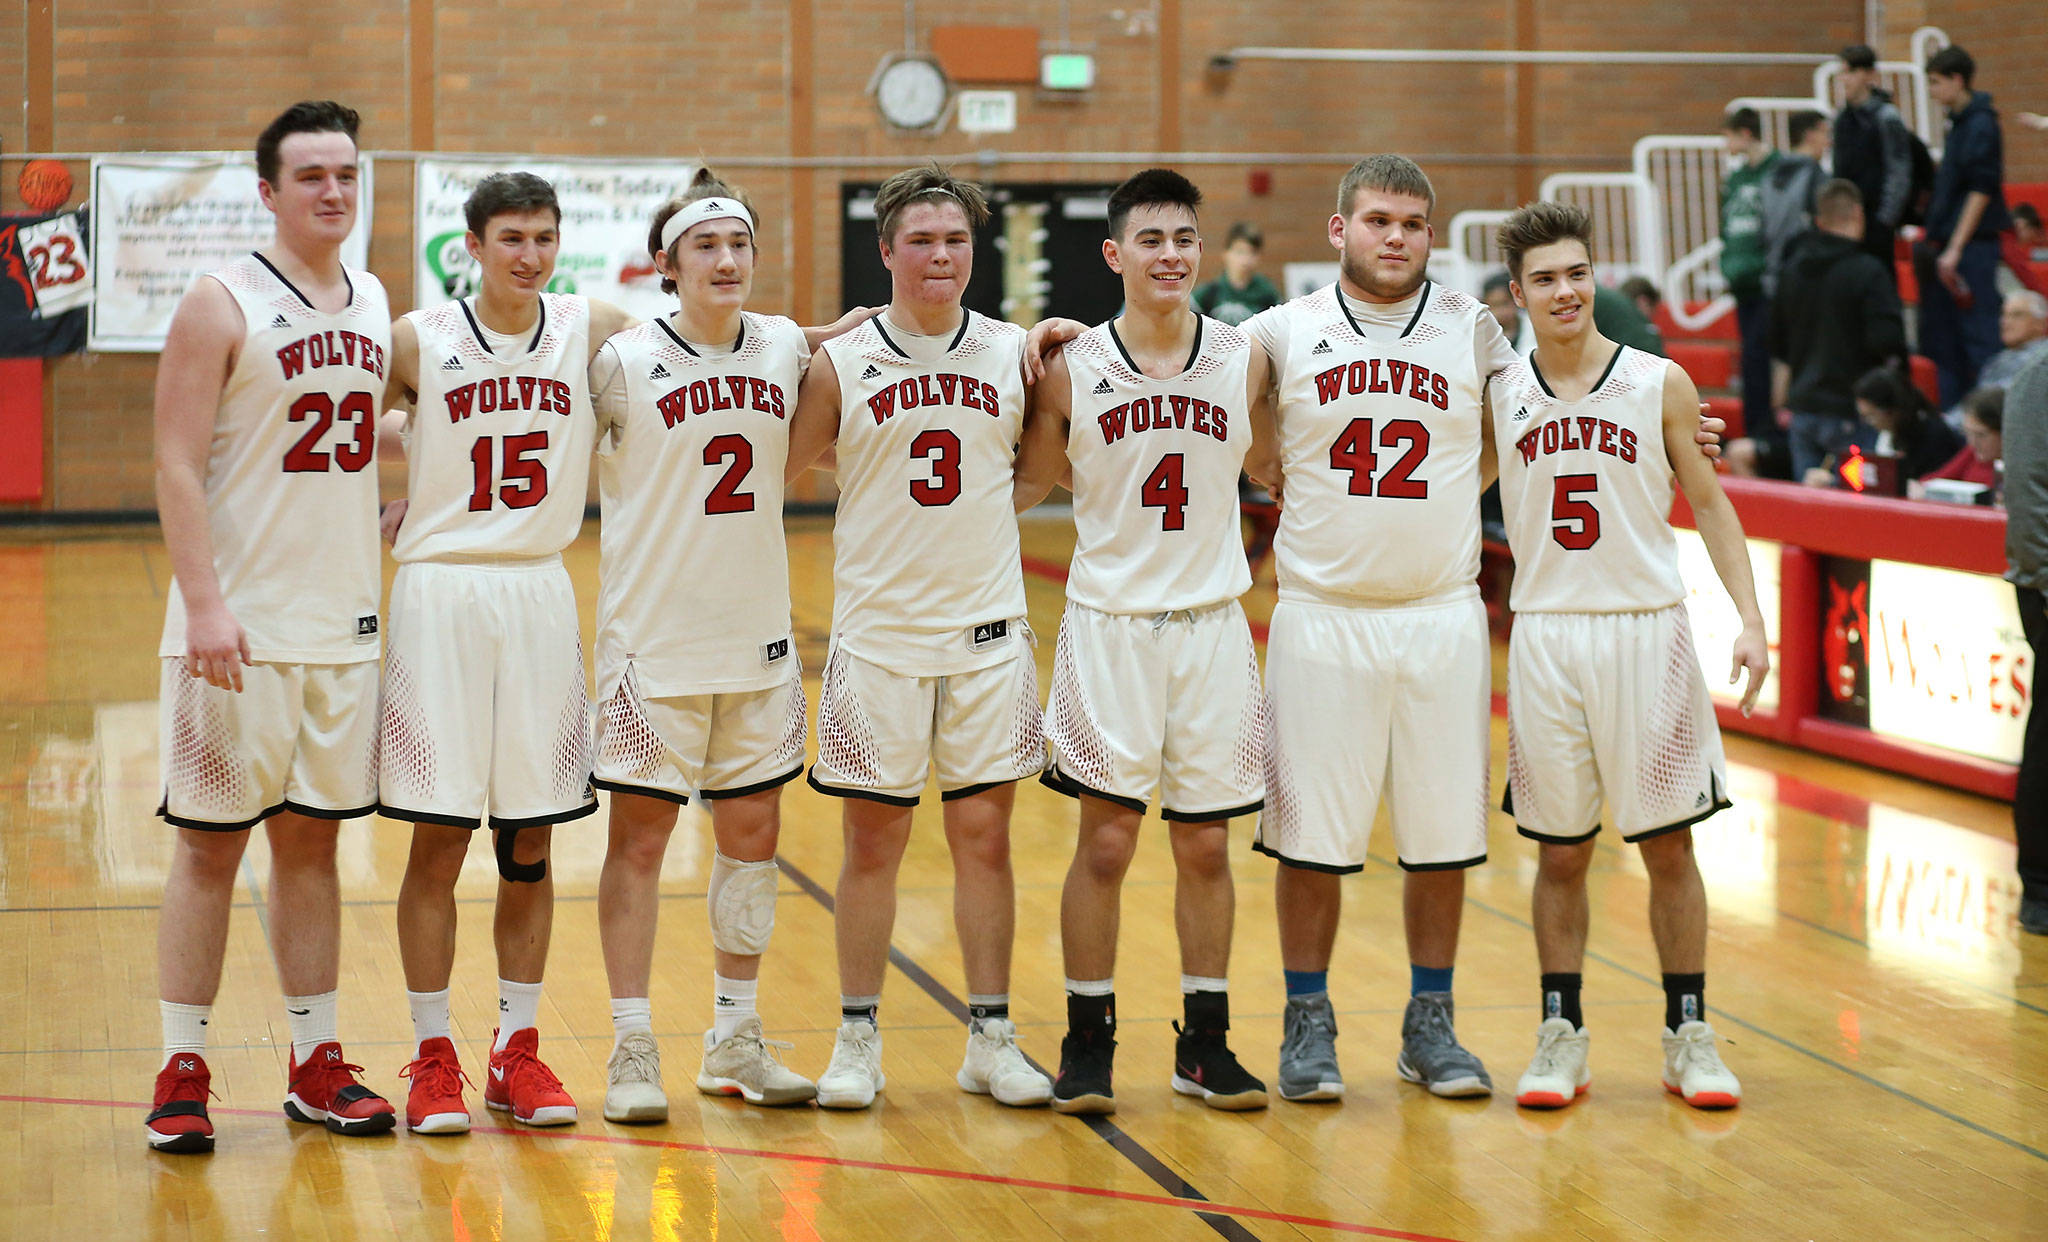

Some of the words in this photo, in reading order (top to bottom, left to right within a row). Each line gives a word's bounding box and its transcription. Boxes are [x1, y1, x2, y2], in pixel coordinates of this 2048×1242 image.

[28, 235, 86, 290] 23
[276, 330, 384, 382] WOLVES
[444, 376, 571, 424] WOLVES
[656, 375, 785, 430] WOLVES
[867, 373, 1000, 426] WOLVES
[1314, 358, 1449, 411] WOLVES
[282, 391, 375, 473] 23
[1097, 394, 1228, 445] WOLVES
[1515, 416, 1638, 468] WOLVES
[468, 430, 549, 513] 15
[703, 433, 755, 515] 2
[909, 428, 962, 507] 3
[1329, 417, 1431, 500] 42
[1141, 452, 1189, 531] 4
[1552, 473, 1601, 551] 5
